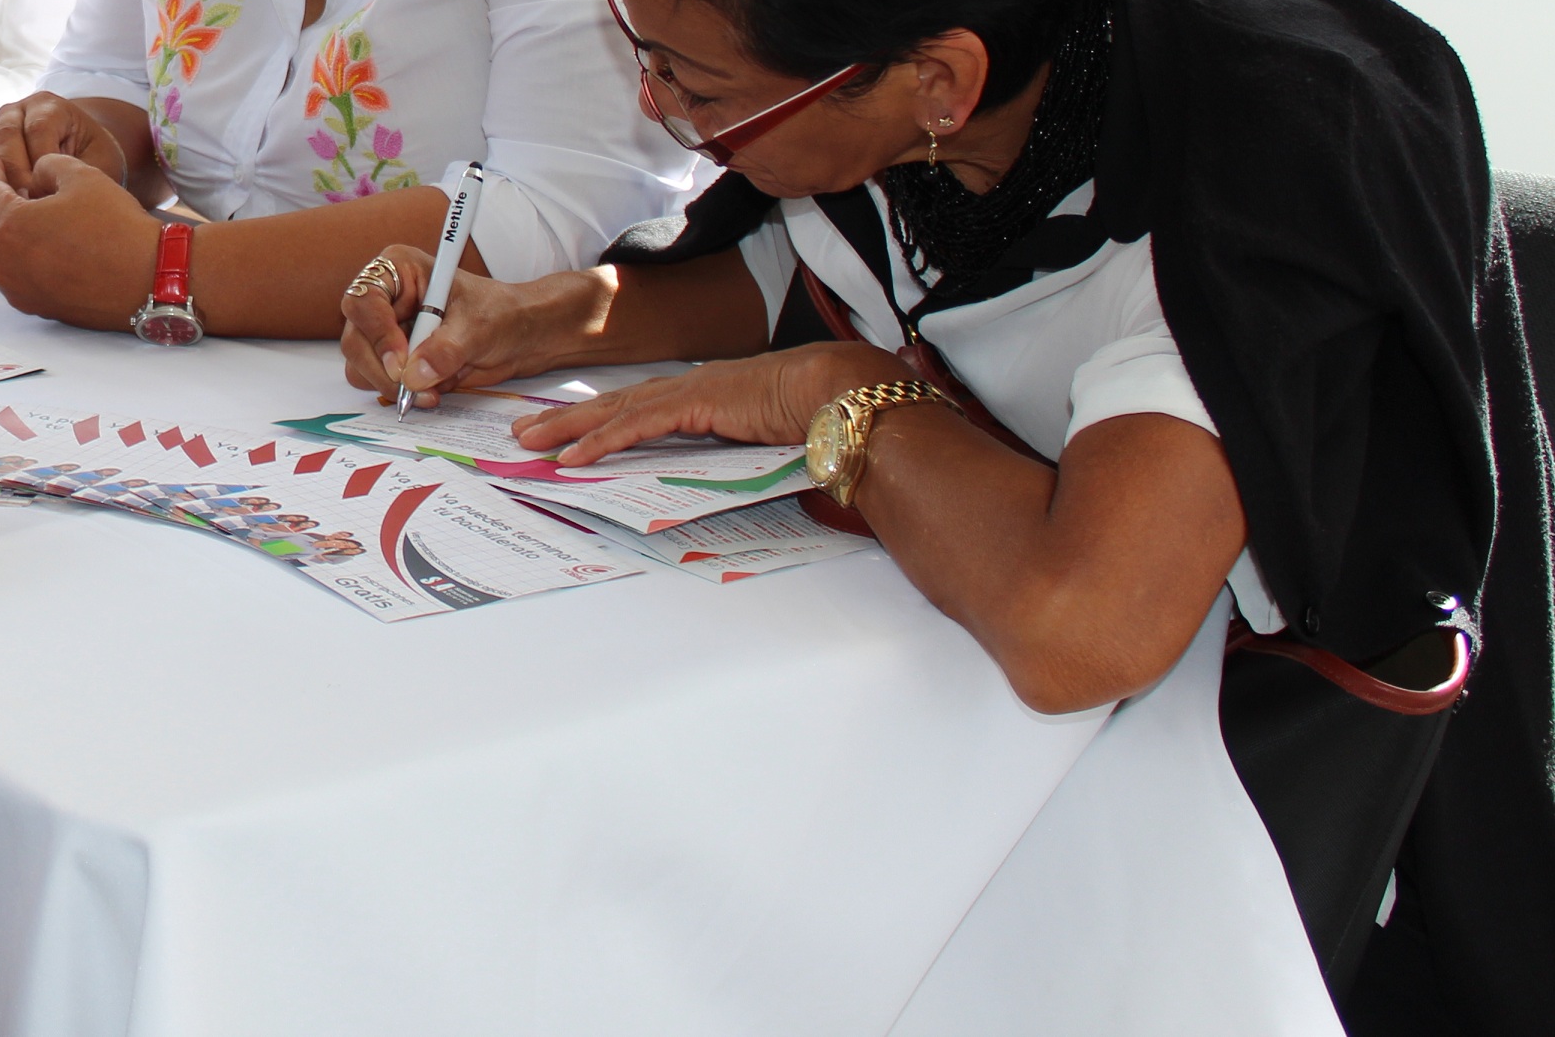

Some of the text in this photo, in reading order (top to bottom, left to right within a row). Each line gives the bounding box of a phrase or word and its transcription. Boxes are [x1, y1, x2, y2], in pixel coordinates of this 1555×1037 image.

[444, 191, 468, 243] MetLife
[336, 457, 357, 468] Ya
[390, 471, 411, 484] Ya
[433, 506, 453, 518] tu
[450, 515, 540, 560] bachillerato
[437, 492, 582, 563] Ya puedes terminar
[558, 567, 589, 582] COBAO
[334, 576, 394, 609] Gratis
